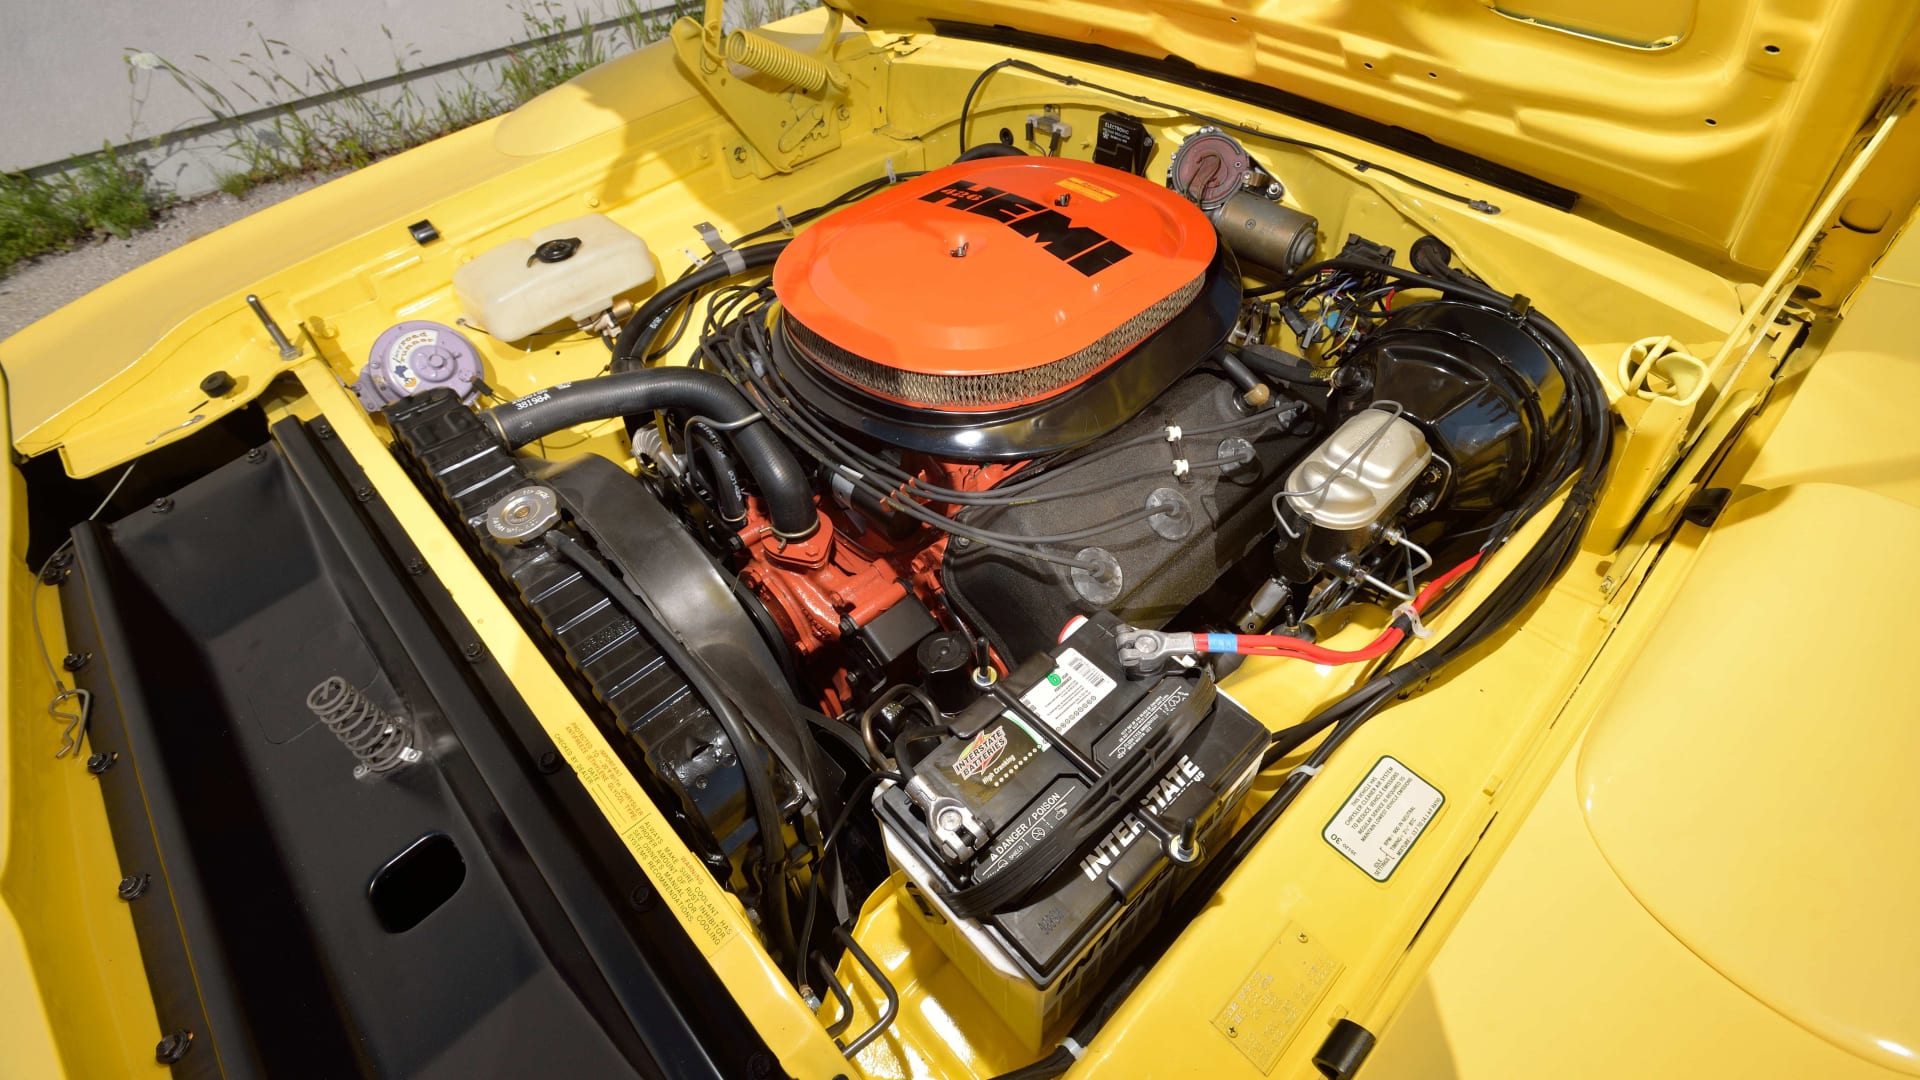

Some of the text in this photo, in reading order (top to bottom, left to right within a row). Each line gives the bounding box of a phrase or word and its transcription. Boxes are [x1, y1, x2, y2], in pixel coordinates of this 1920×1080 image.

[939, 189, 982, 201] 426
[917, 180, 1133, 277] HEMI
[554, 733, 572, 755] CHECKED
[576, 764, 593, 784] DEALER
[955, 730, 1005, 772] INTERSTATE
[963, 738, 1005, 777] BATTERIES
[587, 768, 598, 780] DATE
[607, 783, 624, 803] GLYCOL
[1351, 797, 1359, 806] THIS
[1358, 784, 1370, 797] VEHICLE
[620, 788, 643, 816] CHRYSLER
[1345, 805, 1362, 825] CHRYSLER
[1361, 787, 1376, 804] CLEANER
[1381, 767, 1393, 780] SYSTEM
[1356, 807, 1370, 823] REDUCE
[1369, 791, 1383, 806] VEHICLE
[1381, 772, 1398, 791] EMISSIONS
[1357, 817, 1372, 833] REGULAR
[1371, 802, 1384, 817] SERVICE
[1386, 781, 1401, 798] REQUIRED
[995, 823, 1029, 855] DANGER
[1031, 792, 1061, 820] POISON
[1330, 833, 1341, 843] 30
[1361, 824, 1376, 841] MAINTAIN
[1374, 809, 1387, 824] LOWEST
[1386, 795, 1398, 809] VEHICLE
[627, 834, 648, 860] SYSTEMS
[1374, 857, 1390, 875] SETTINGS
[632, 830, 720, 945] SEE OWNER'S MANUAL FOR COOLING
[638, 825, 725, 938] PROPER AMOUNT OF RUST INHIBITOR
[644, 821, 732, 934] ALWAYS MAKE SURE COOLANT HAS
[680, 856, 704, 884] WARNING
